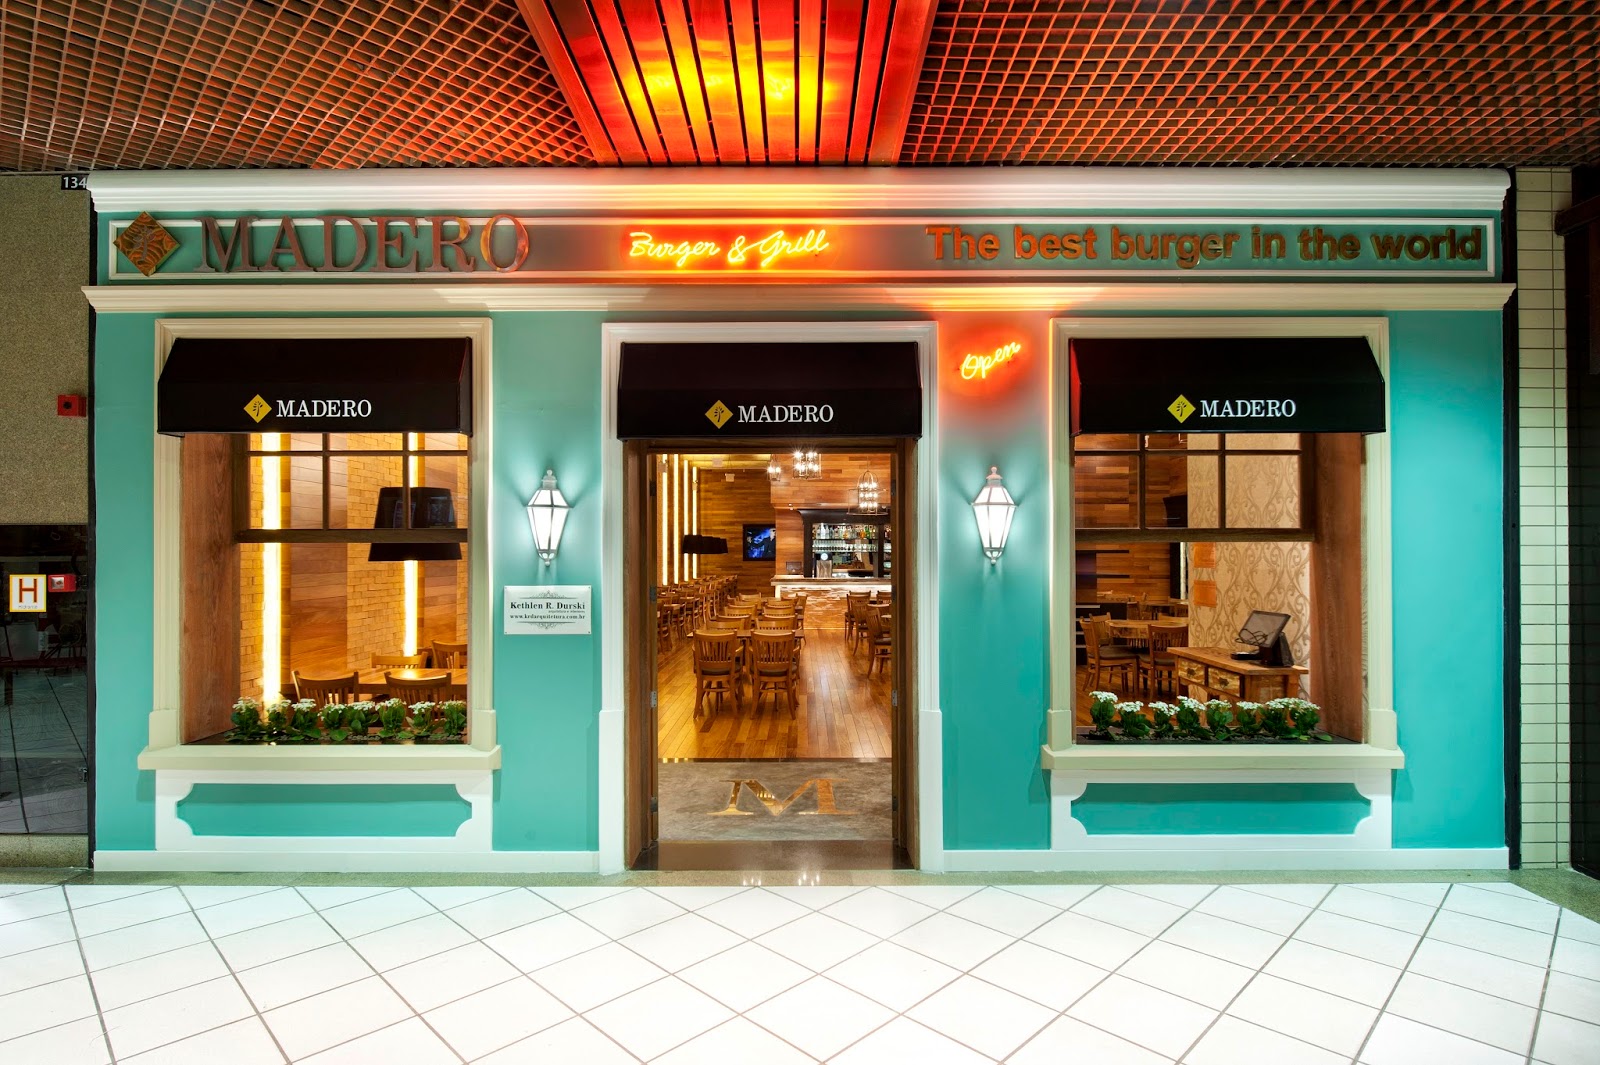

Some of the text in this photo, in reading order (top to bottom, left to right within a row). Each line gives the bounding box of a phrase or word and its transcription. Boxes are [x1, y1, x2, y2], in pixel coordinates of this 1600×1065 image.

[63, 176, 87, 189] 134
[198, 214, 531, 273] MADERO
[629, 229, 830, 268] Burger & Grill
[925, 225, 1482, 269] The best burger in the world
[961, 341, 1021, 379] Open
[276, 399, 372, 417] MADERO
[737, 404, 834, 423] MADERO
[1199, 399, 1296, 417] MADERO
[19, 578, 37, 603] H
[706, 779, 859, 816] M
